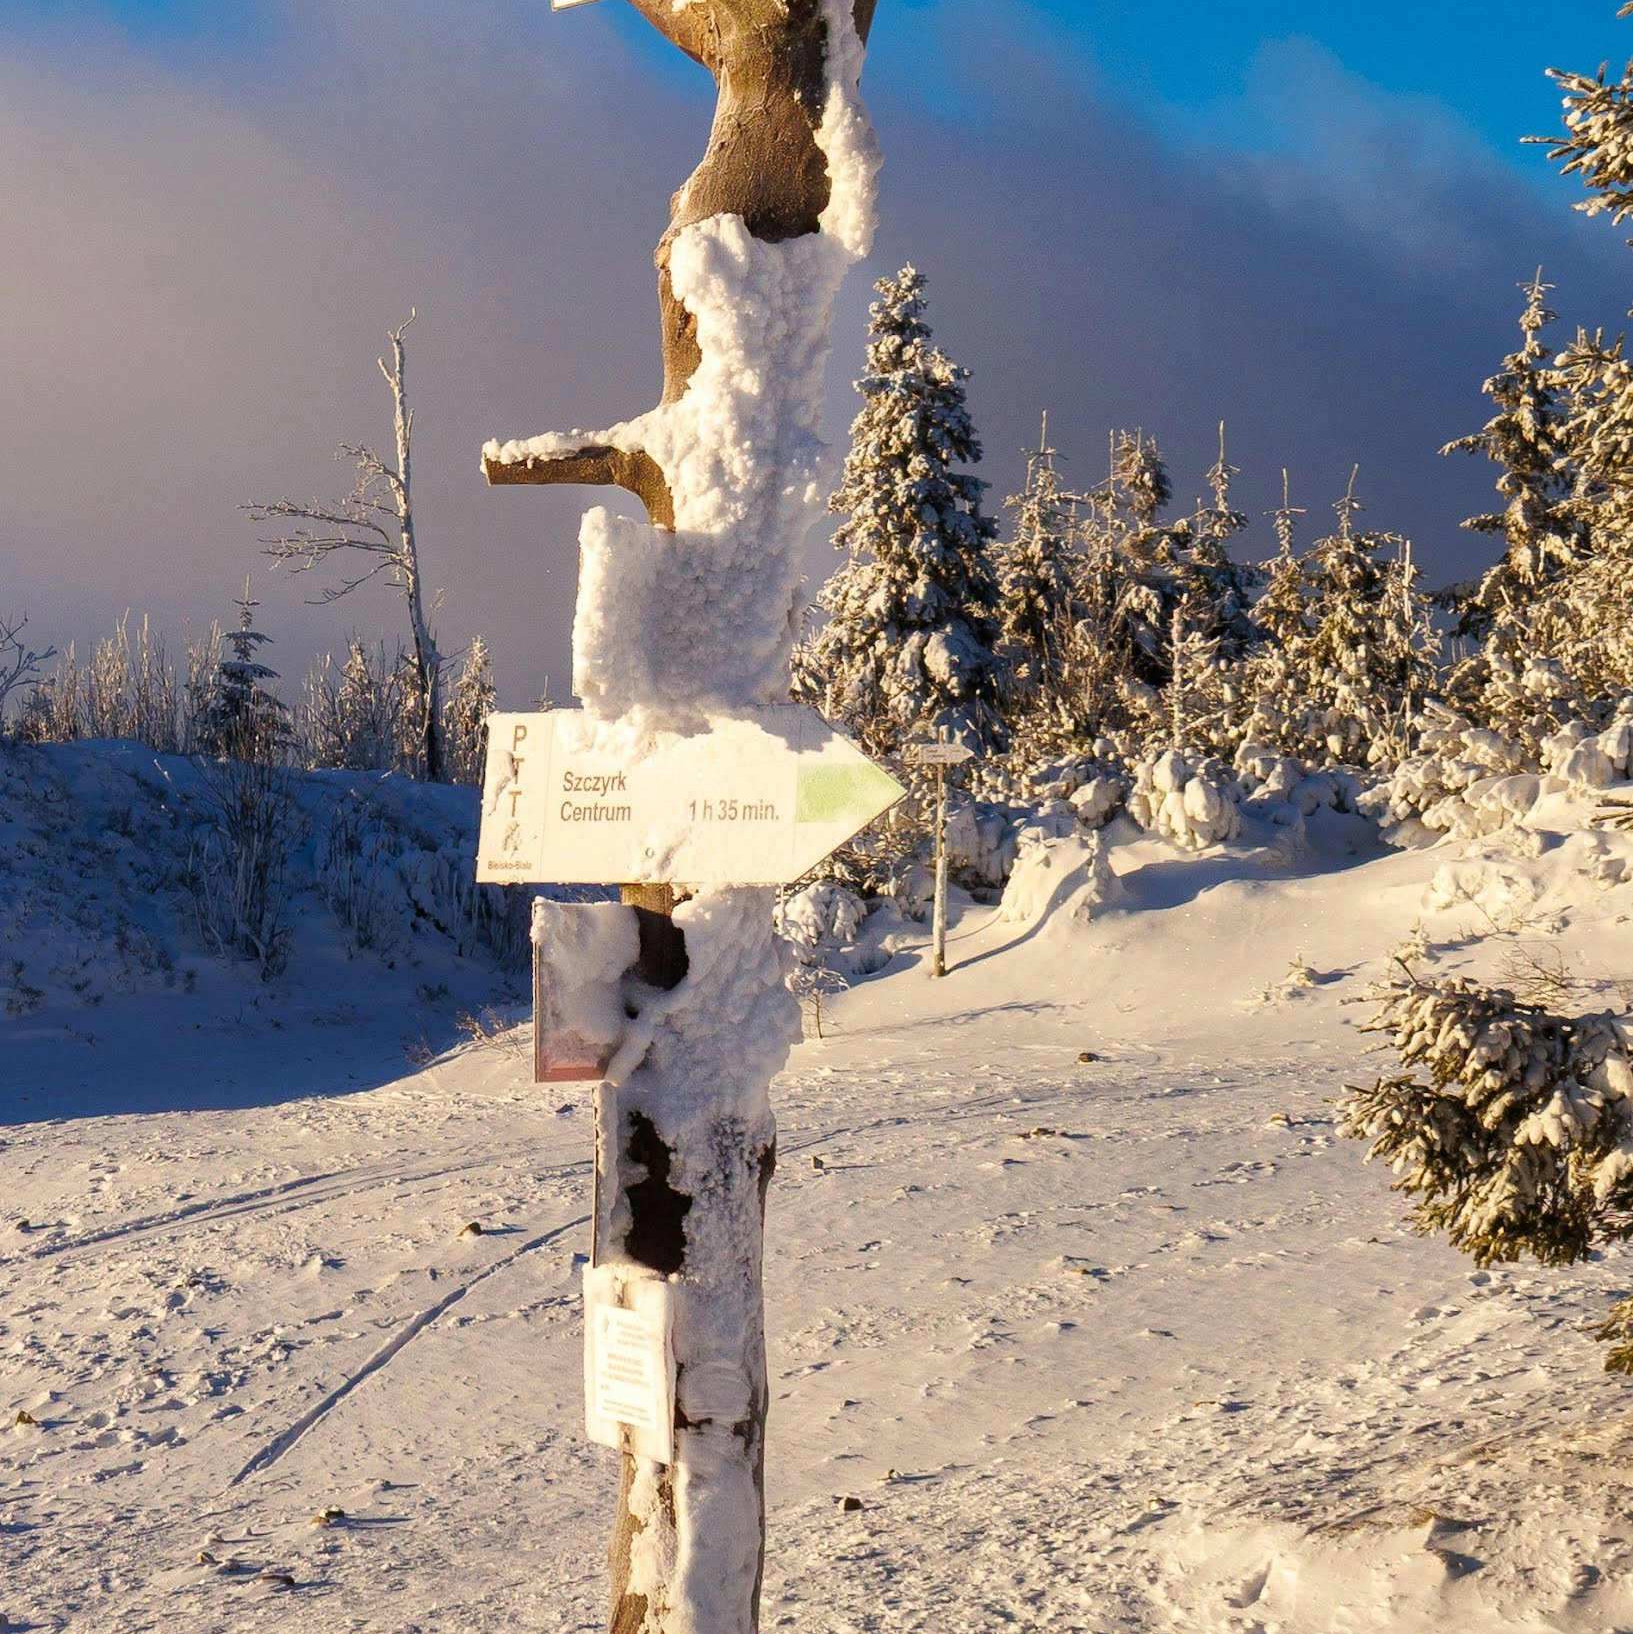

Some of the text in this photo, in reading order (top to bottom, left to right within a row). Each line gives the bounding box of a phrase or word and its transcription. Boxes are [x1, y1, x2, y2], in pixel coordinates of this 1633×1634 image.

[562, 769, 627, 797] Szczyrk
[560, 799, 780, 822] Centrum 1 h 35 min.
